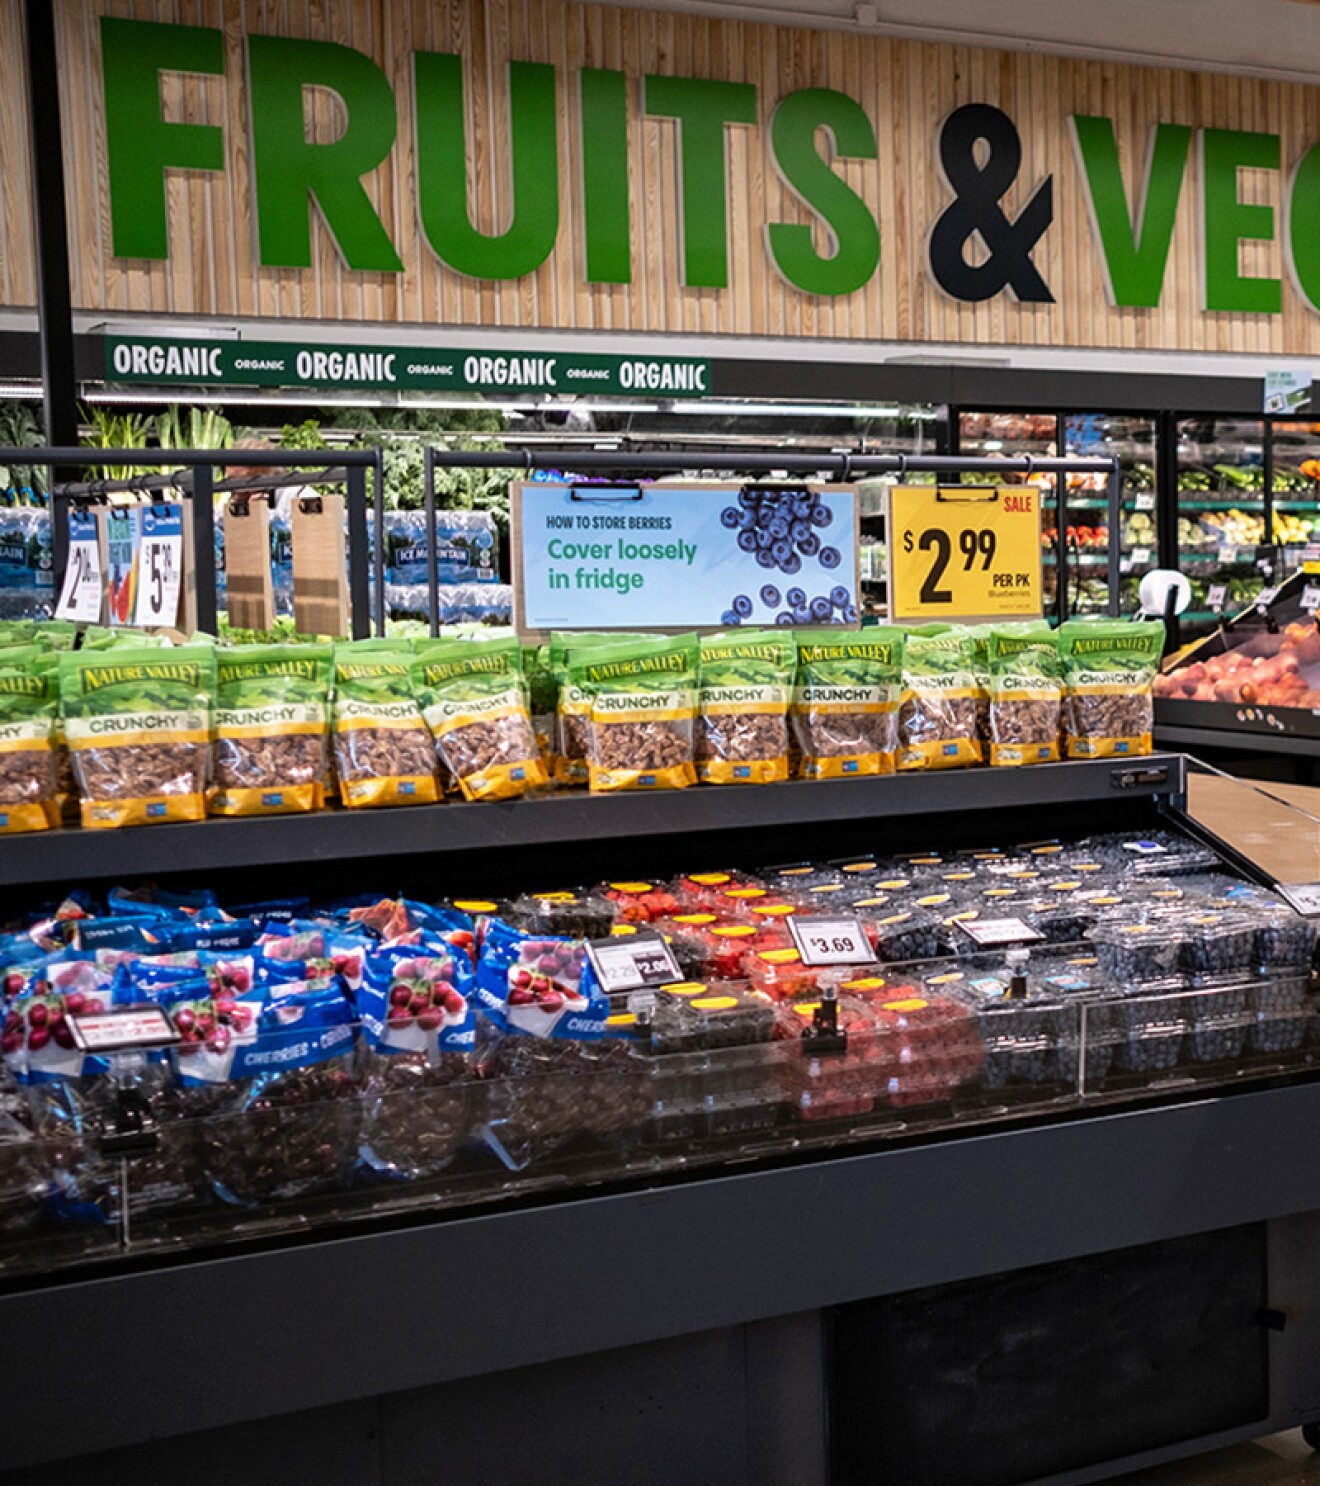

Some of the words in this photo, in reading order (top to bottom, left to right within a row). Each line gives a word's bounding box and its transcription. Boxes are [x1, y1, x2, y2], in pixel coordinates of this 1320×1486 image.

[101, 17, 882, 297] FRUITS
[929, 102, 1055, 304] &
[113, 344, 222, 377] ORGANIC
[234, 359, 285, 371] ORGANIC
[296, 350, 397, 382] ORGANIC
[407, 364, 453, 376] ORGANIC
[463, 355, 557, 387] ORGANIC
[567, 368, 610, 380] ORGANIC
[619, 360, 706, 391] ORGANIC
[1004, 496, 1032, 513] SALE
[546, 515, 573, 529] HOW
[575, 515, 591, 529] TO
[591, 515, 627, 530] STORE
[628, 516, 673, 530] BERRIES
[547, 538, 613, 560] Cover
[618, 538, 698, 565] loosely
[548, 567, 570, 589] in
[576, 568, 645, 595] fridge
[992, 573, 1014, 587] PER
[1015, 573, 1030, 587] PK
[700, 648, 735, 662] ATURE
[735, 645, 778, 662] VALLEY
[801, 645, 845, 664] NATURE
[847, 646, 890, 663] VALLEY
[1074, 640, 1114, 655] NATURE
[1116, 638, 1150, 651] VALLEY
[220, 664, 263, 681] ATURE
[265, 659, 317, 680] VALLEY
[590, 660, 640, 682] NATURE
[638, 653, 684, 674] VALLEY
[85, 664, 144, 692] NATURE
[146, 663, 198, 685] VALLEY
[1078, 673, 1137, 685] CRUNCHY
[597, 696, 671, 711] CRUNCHY
[702, 689, 764, 701] RUNCHY
[803, 689, 872, 701] CRUNCHY
[443, 697, 509, 716] CRUNCHY
[89, 715, 179, 734] CRUNCHY
[809, 936, 855, 954] $3.69
[244, 1042, 309, 1065] CHERRIES
